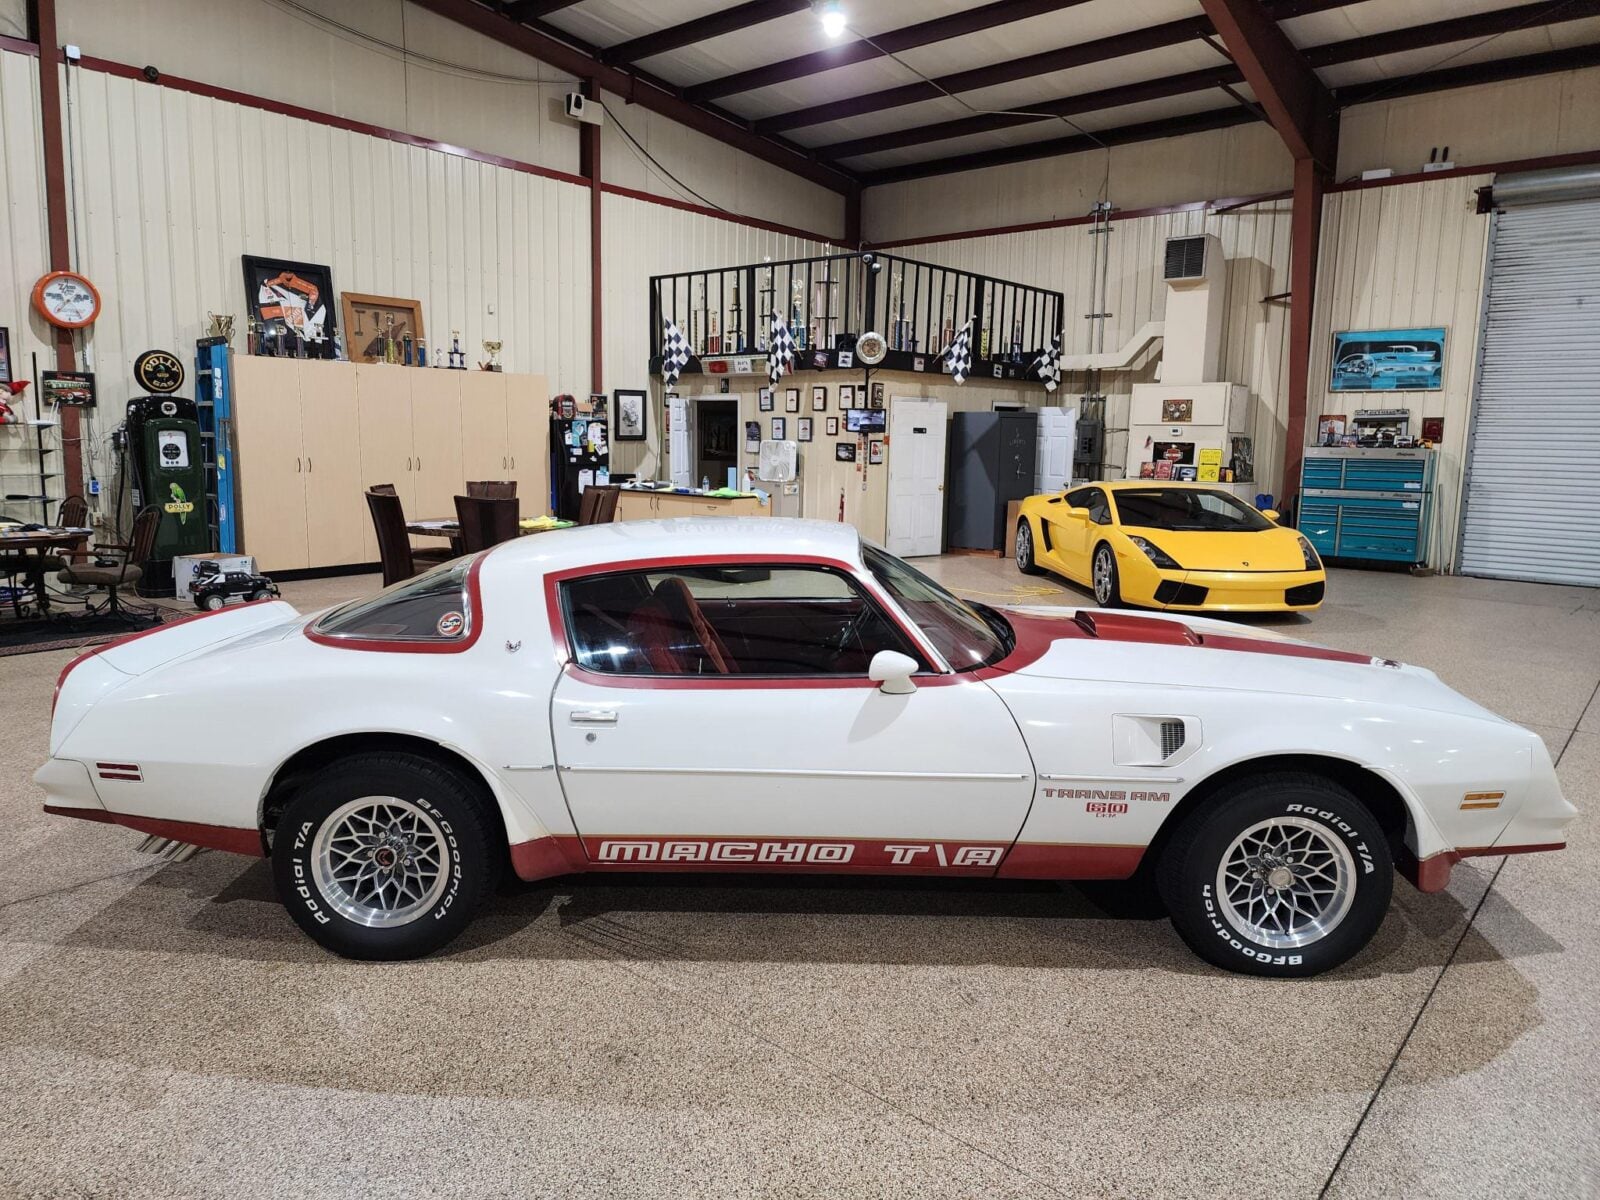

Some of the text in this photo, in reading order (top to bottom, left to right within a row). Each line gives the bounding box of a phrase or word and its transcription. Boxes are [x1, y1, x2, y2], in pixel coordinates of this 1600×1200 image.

[145, 357, 179, 373] POLLY
[1042, 788, 1170, 802] TRANS AM
[293, 821, 331, 925] Radial T/A
[416, 798, 463, 921] BFGoodrich
[597, 841, 855, 863] MACHO
[1286, 803, 1375, 875] Radial T/A
[1201, 884, 1303, 966] BFGoodrich
